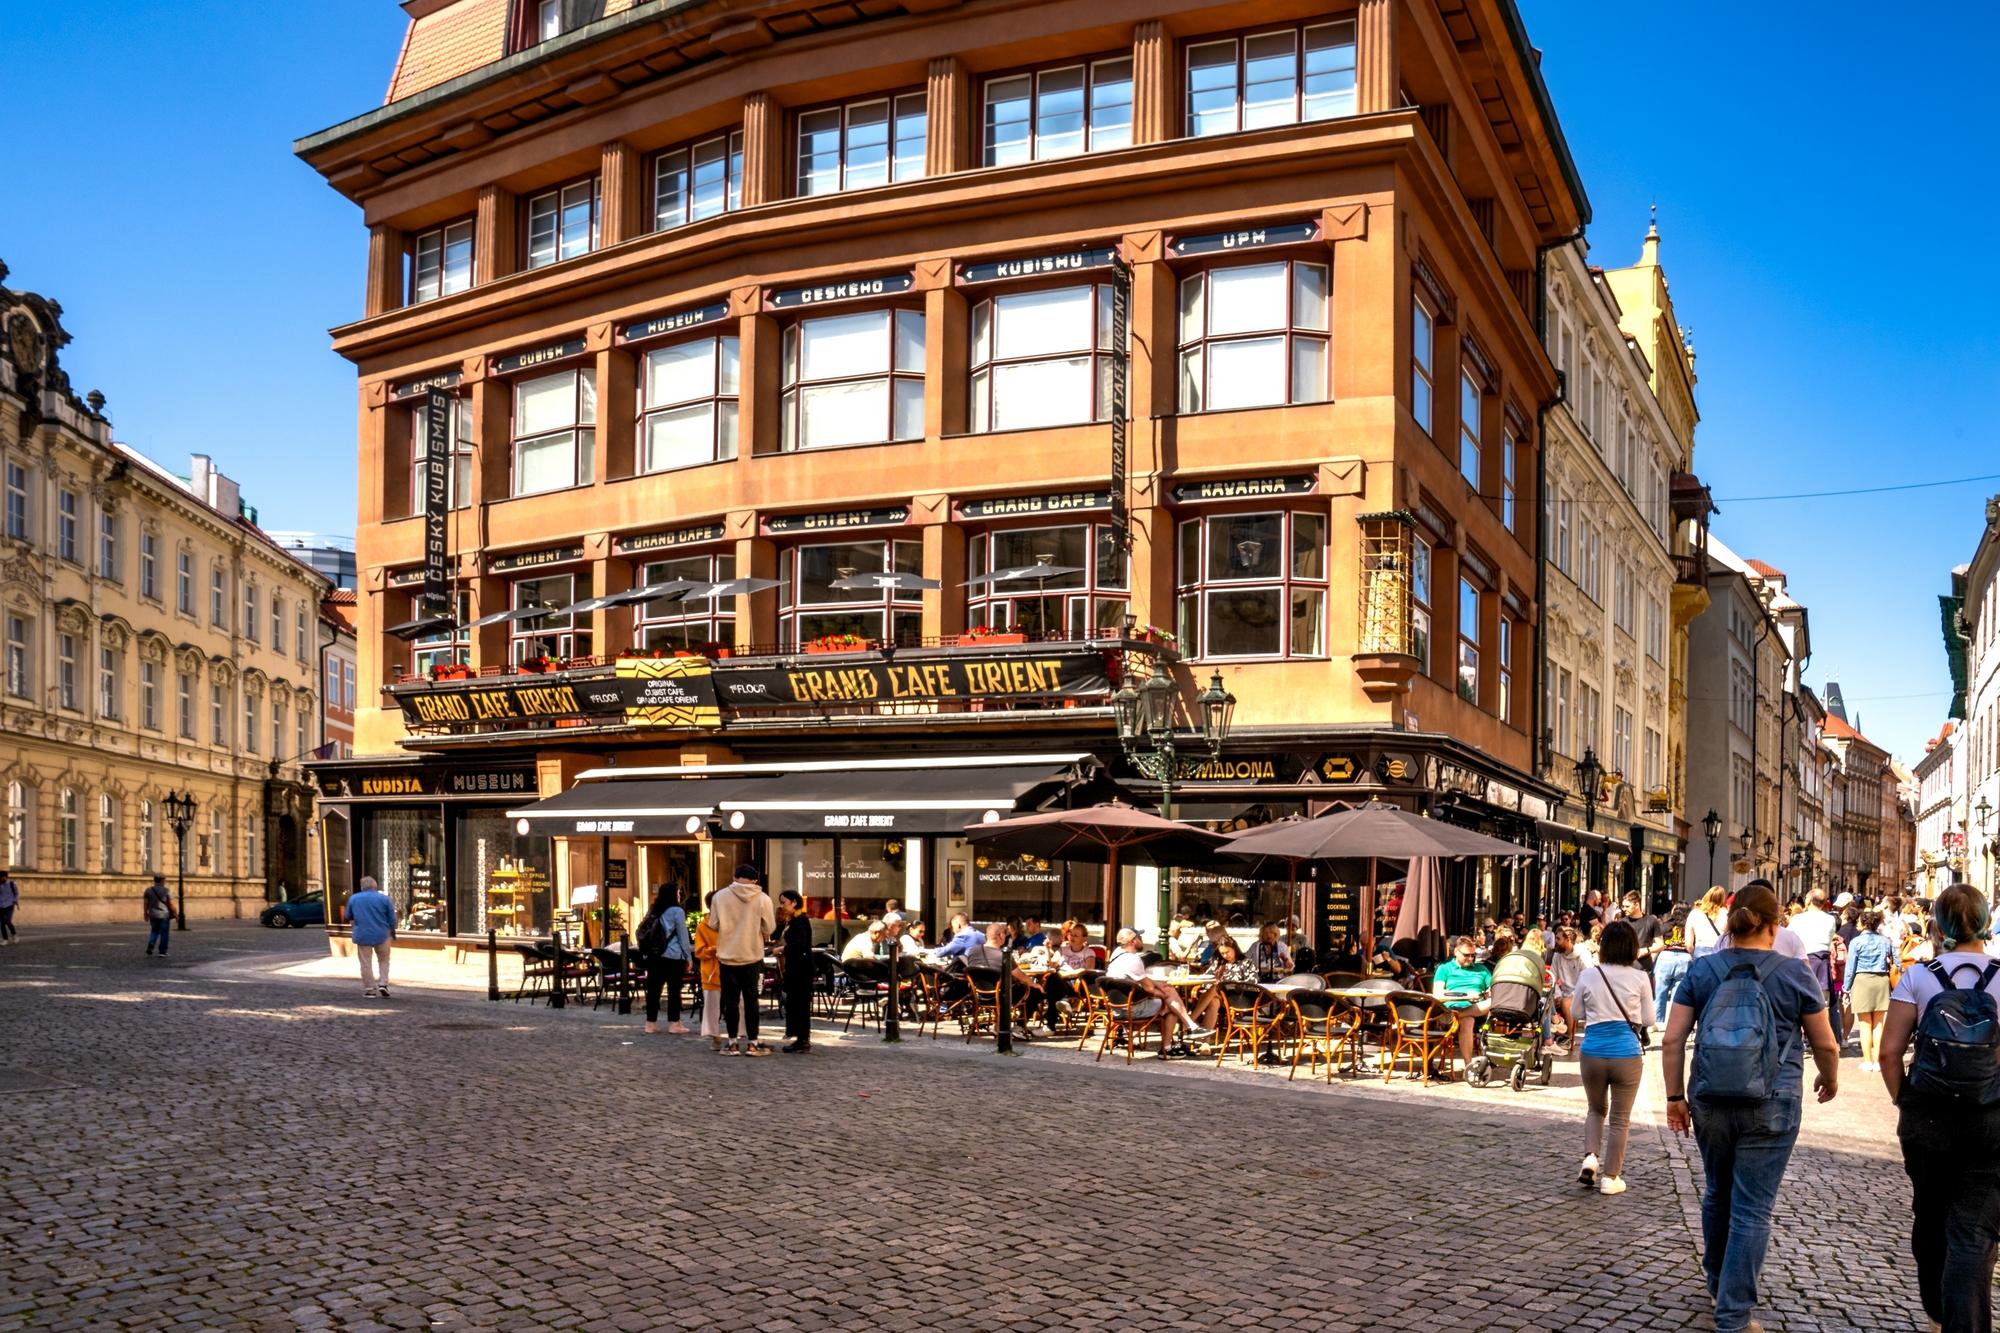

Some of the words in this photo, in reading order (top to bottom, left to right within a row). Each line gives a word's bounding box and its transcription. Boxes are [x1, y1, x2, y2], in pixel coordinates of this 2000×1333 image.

[1223, 231, 1266, 248] UPM
[998, 254, 1083, 276] KUBISMU
[647, 310, 704, 333] MUSEUM
[1113, 290, 1125, 357] ORIENT
[519, 346, 563, 367] CUBISM
[1113, 363, 1125, 407] CAFE
[430, 395, 446, 504] KUBISMUS
[1113, 416, 1125, 480] GRAND
[982, 497, 1042, 515] GRAND
[1047, 492, 1096, 510] CAFE
[804, 511, 872, 528] ORIENT
[426, 511, 444, 582] ČESKÝ
[633, 532, 676, 550] GRAND
[516, 550, 561, 566] ORIENT
[647, 680, 677, 688] ORIGINAL
[788, 669, 879, 702] GRAND
[887, 664, 956, 697] CAFE
[964, 660, 1062, 694] ORIENT
[658, 696, 675, 704] CAFE
[675, 695, 698, 704] ORIENT
[667, 687, 685, 696] CAFE
[414, 694, 469, 722] GRAND
[470, 690, 516, 719] CAFE
[515, 686, 581, 716] ORIENT
[1195, 761, 1275, 779] MADONA
[362, 777, 424, 794] KUBISTA
[453, 773, 525, 791] MUSEUM
[847, 871, 881, 880] RESTAURANT
[978, 874, 1002, 882] UNIQUE
[1025, 874, 1061, 883] RESTAURANT
